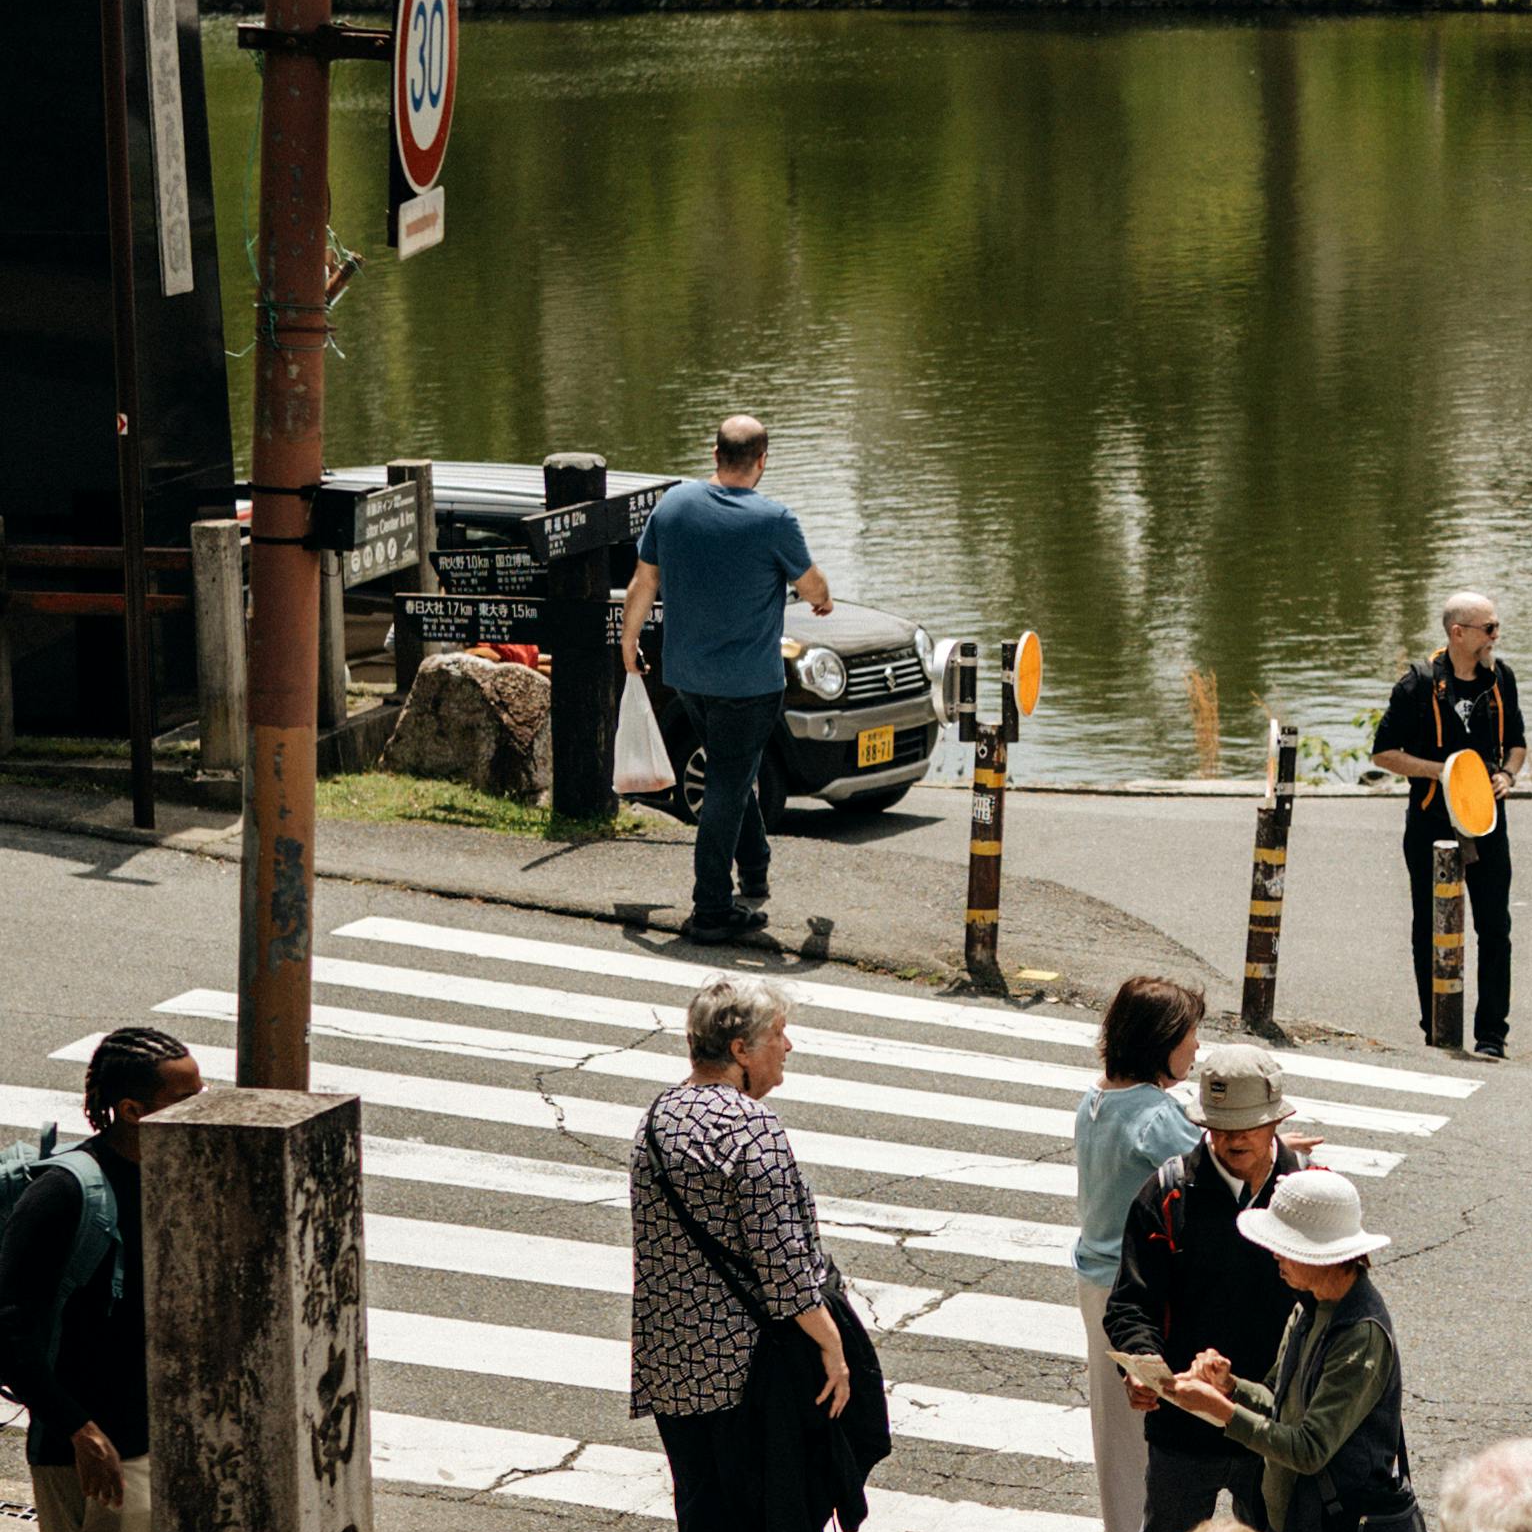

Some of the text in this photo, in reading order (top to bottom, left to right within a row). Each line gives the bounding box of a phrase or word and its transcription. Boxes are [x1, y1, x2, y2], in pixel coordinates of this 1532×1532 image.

[405, 600, 444, 615] 春日大社
[478, 603, 509, 618] 東大寺
[511, 604, 538, 619] 1.5km
[865, 740, 890, 763] 88-71
